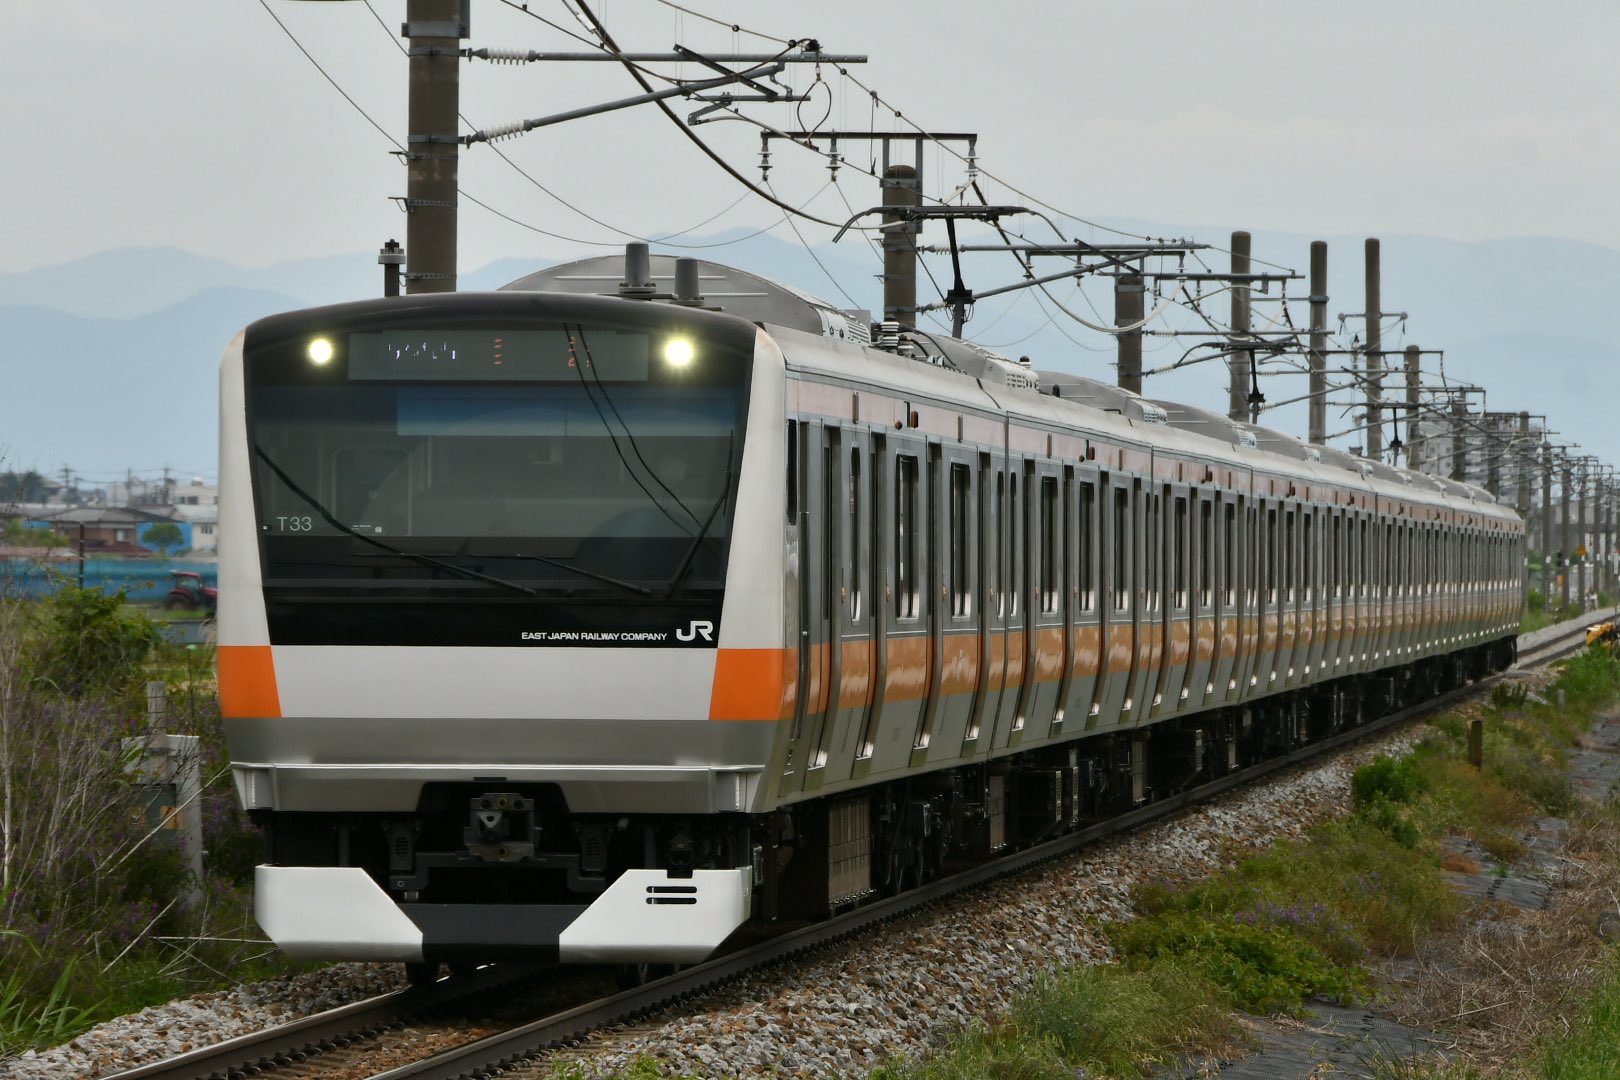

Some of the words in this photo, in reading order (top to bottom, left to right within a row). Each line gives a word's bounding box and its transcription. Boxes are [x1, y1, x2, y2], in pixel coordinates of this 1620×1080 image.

[277, 516, 312, 532] T33
[521, 632, 547, 640] EAST
[547, 632, 579, 640] JAPAN
[581, 632, 620, 641] RAILWAY
[620, 632, 668, 641] COMPANY
[676, 620, 713, 642] JR
